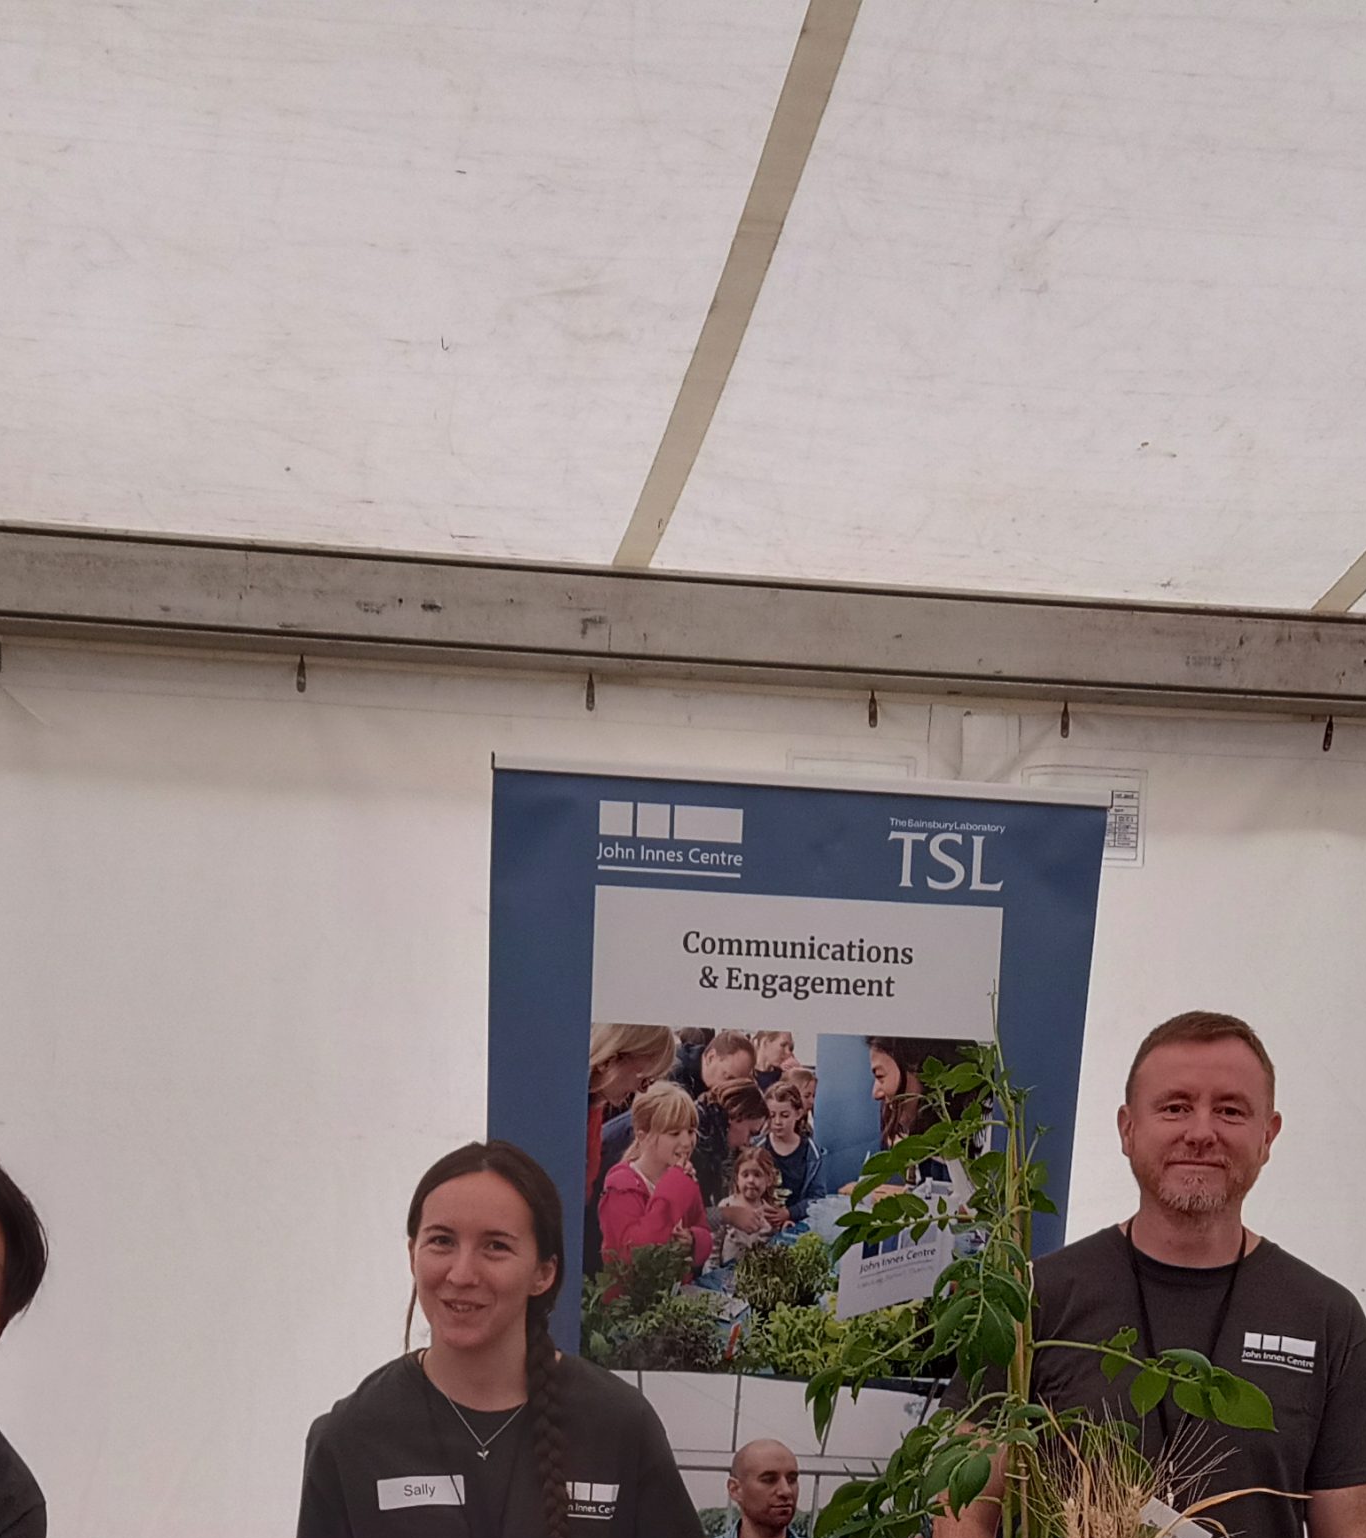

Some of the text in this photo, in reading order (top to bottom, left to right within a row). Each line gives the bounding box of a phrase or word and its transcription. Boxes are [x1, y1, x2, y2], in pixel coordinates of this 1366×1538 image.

[596, 842, 743, 866] John Innes Centre
[888, 830, 1004, 891] TSL
[682, 930, 914, 965] Communications
[698, 965, 895, 1000] & Engagement
[860, 1248, 936, 1274] John Innes Centre
[1241, 1350, 1314, 1368] John Innes Centre
[403, 1484, 436, 1498] Sally
